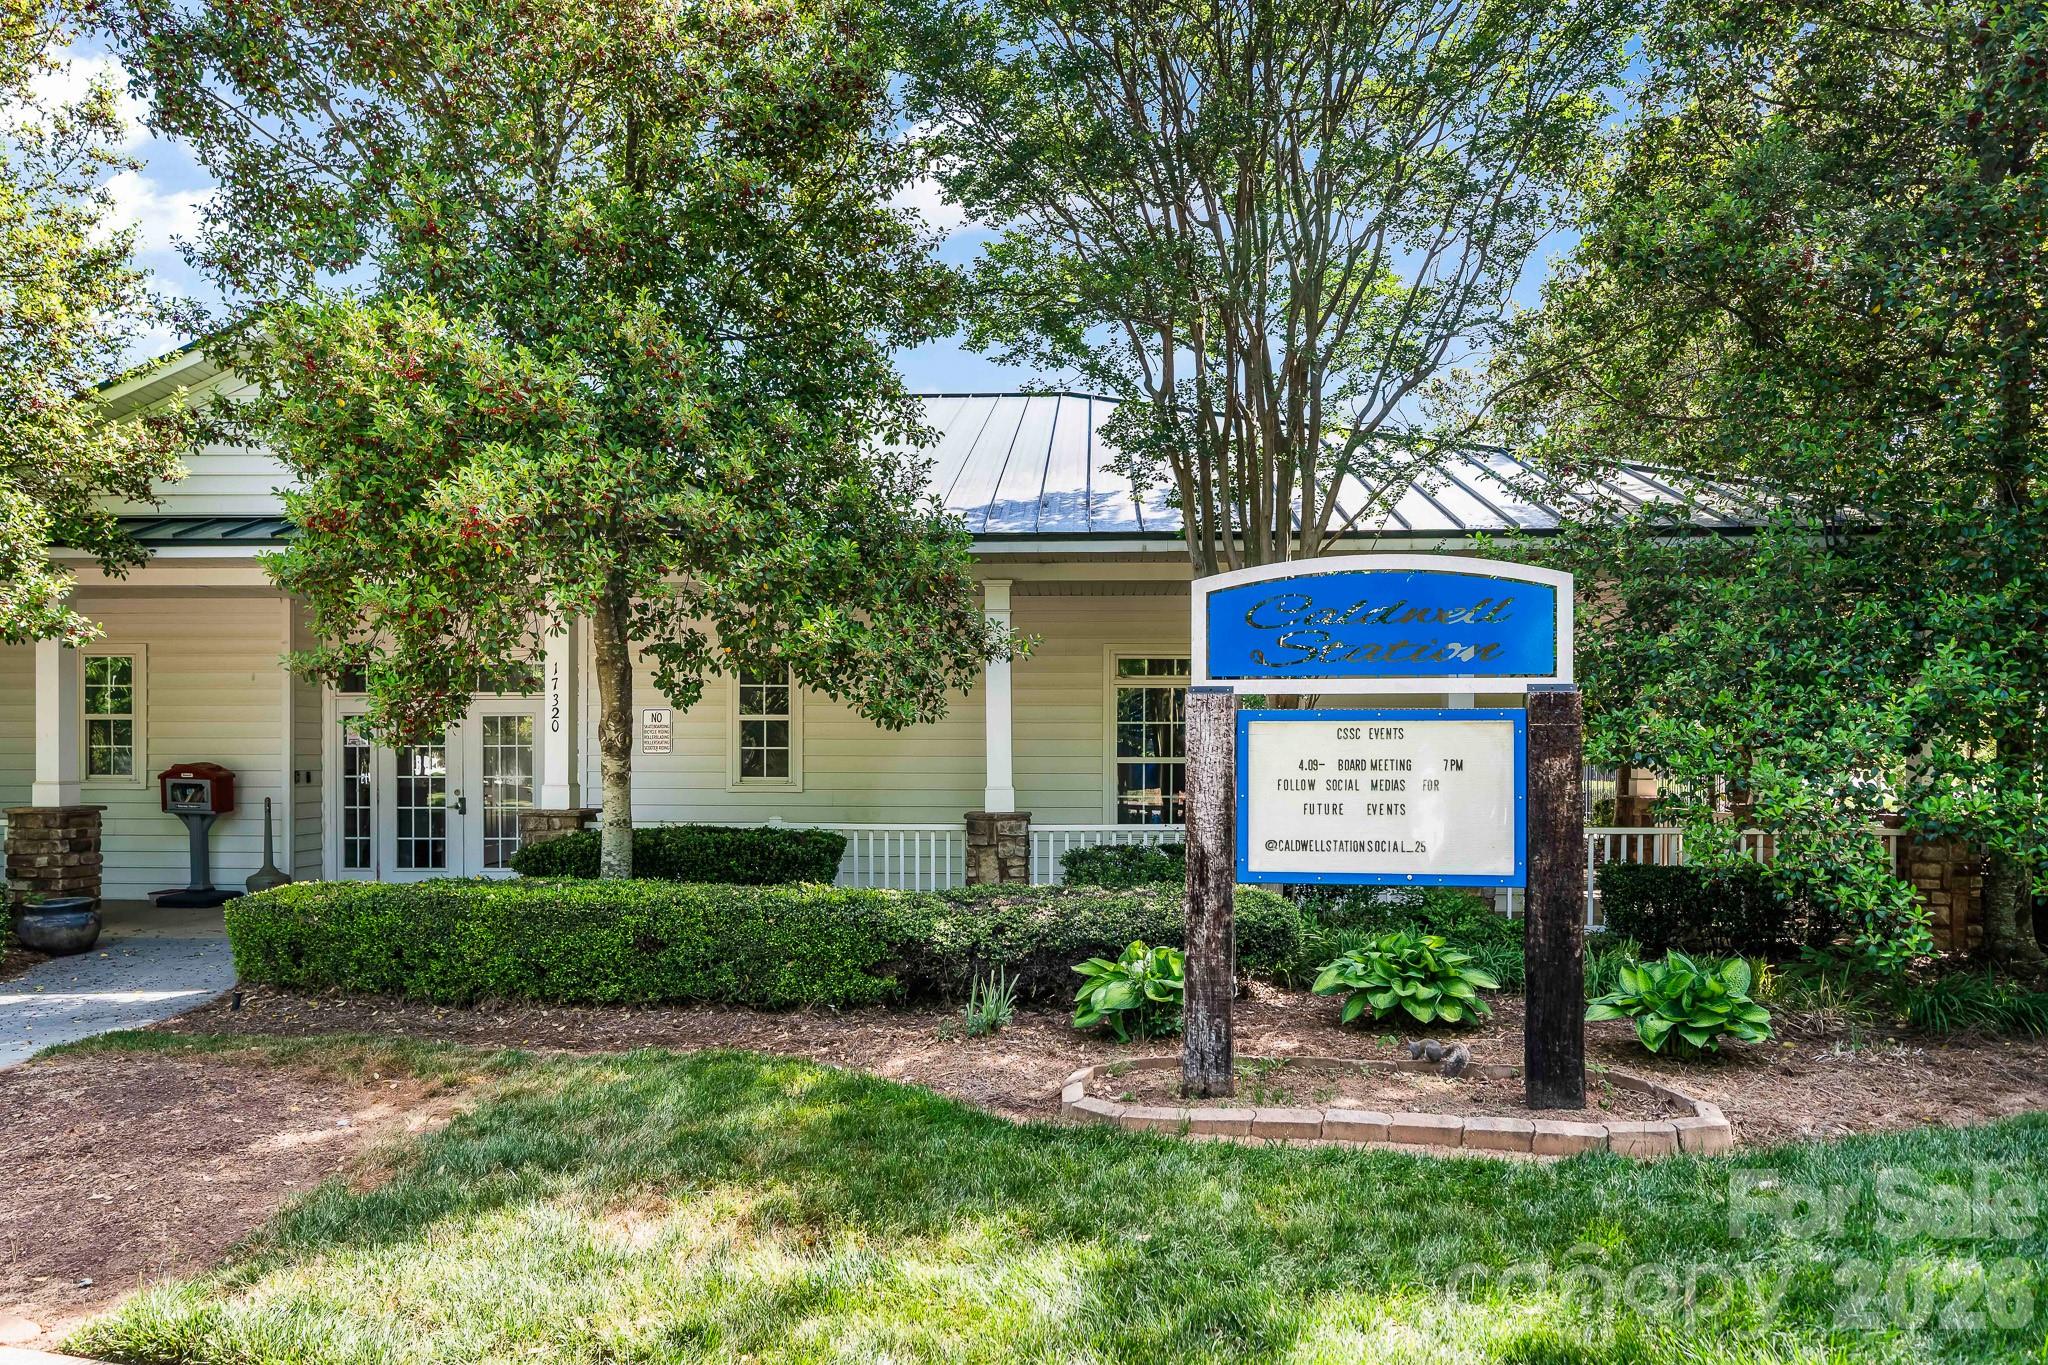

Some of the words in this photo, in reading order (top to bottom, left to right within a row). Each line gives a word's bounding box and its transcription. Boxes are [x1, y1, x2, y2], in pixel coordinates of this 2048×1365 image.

[1244, 593, 1516, 630] Caldwell
[1250, 629, 1505, 668] Station
[551, 662, 560, 733] 17320
[651, 712, 663, 723] NO
[1337, 727, 1361, 740] CSSC
[1369, 727, 1404, 740] EVENTS
[1338, 759, 1367, 771] BOARD
[1370, 759, 1412, 771] MEETING
[1277, 779, 1316, 791] FOLLOW
[1326, 779, 1360, 791] SOCIAL
[1370, 779, 1406, 791] MEDIAS
[1422, 779, 1440, 792] FOR
[1303, 803, 1344, 816] FUTURE
[1367, 803, 1406, 816] EVENTS
